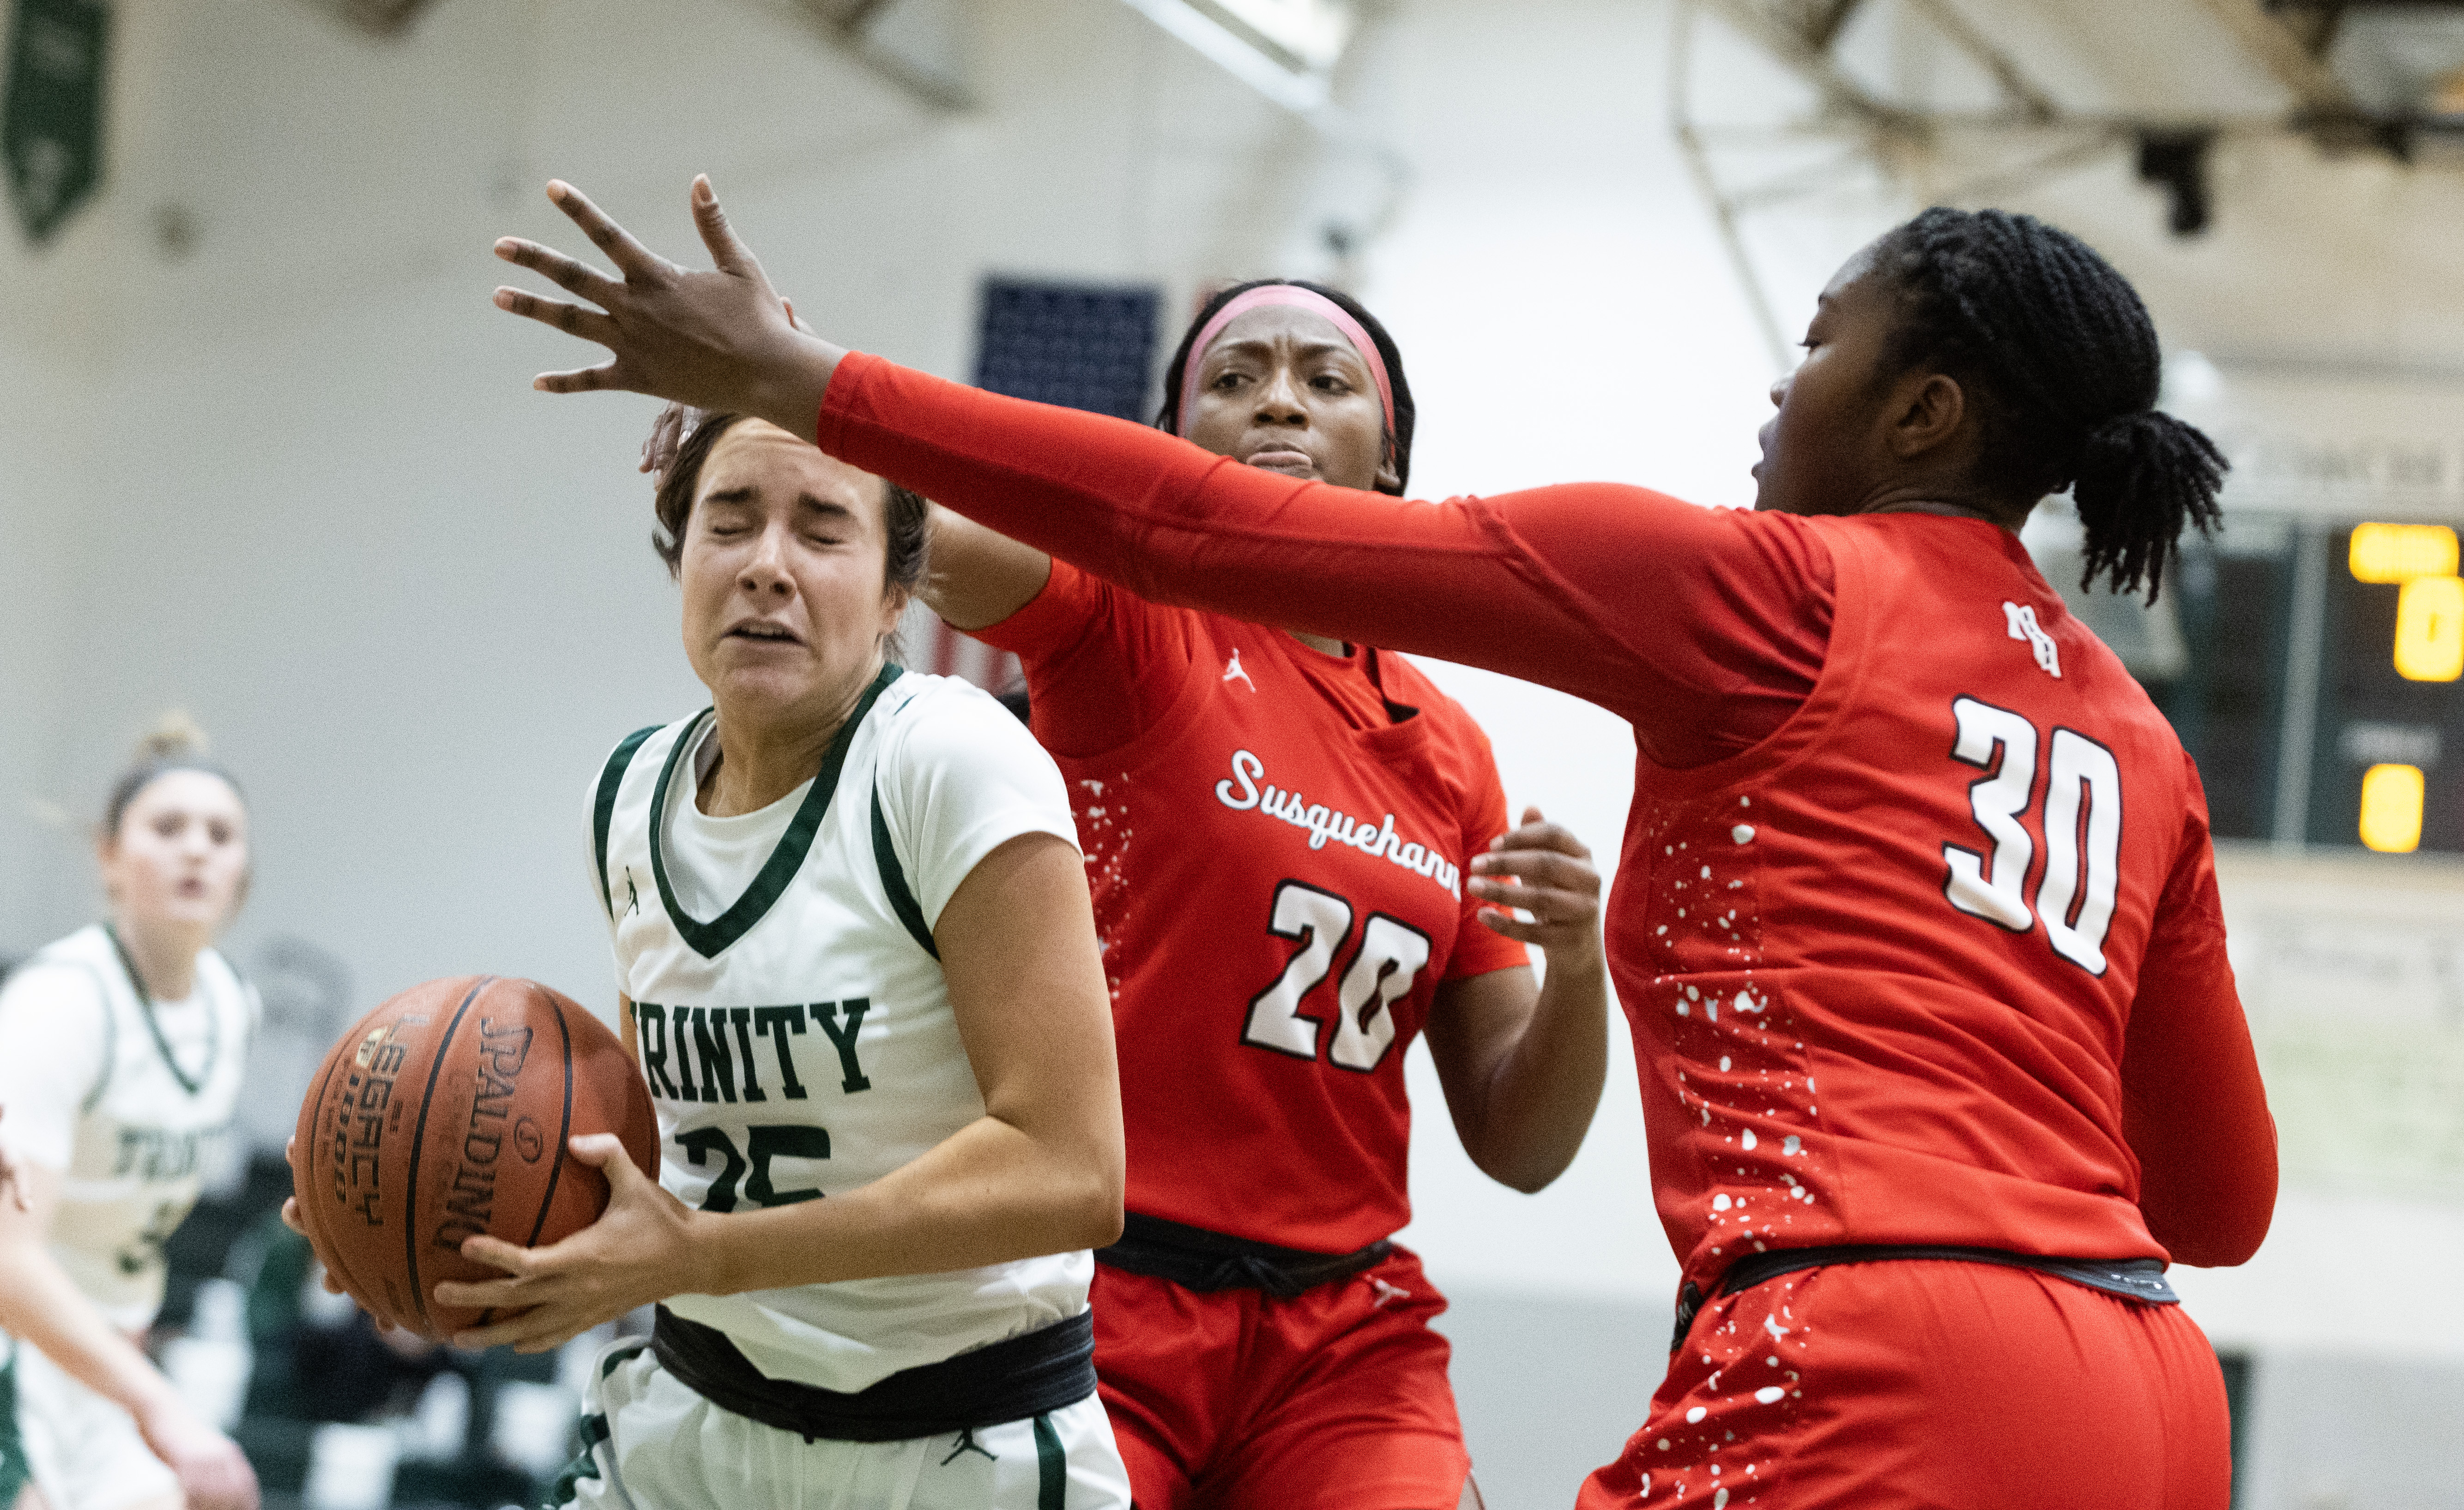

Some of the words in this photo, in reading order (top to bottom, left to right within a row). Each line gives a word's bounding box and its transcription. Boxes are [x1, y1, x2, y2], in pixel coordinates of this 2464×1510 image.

[1942, 692, 2123, 978] 30
[630, 997, 871, 1103] RINITY
[1240, 878, 1433, 1074] 20
[351, 1012, 429, 1227] LEGACY
